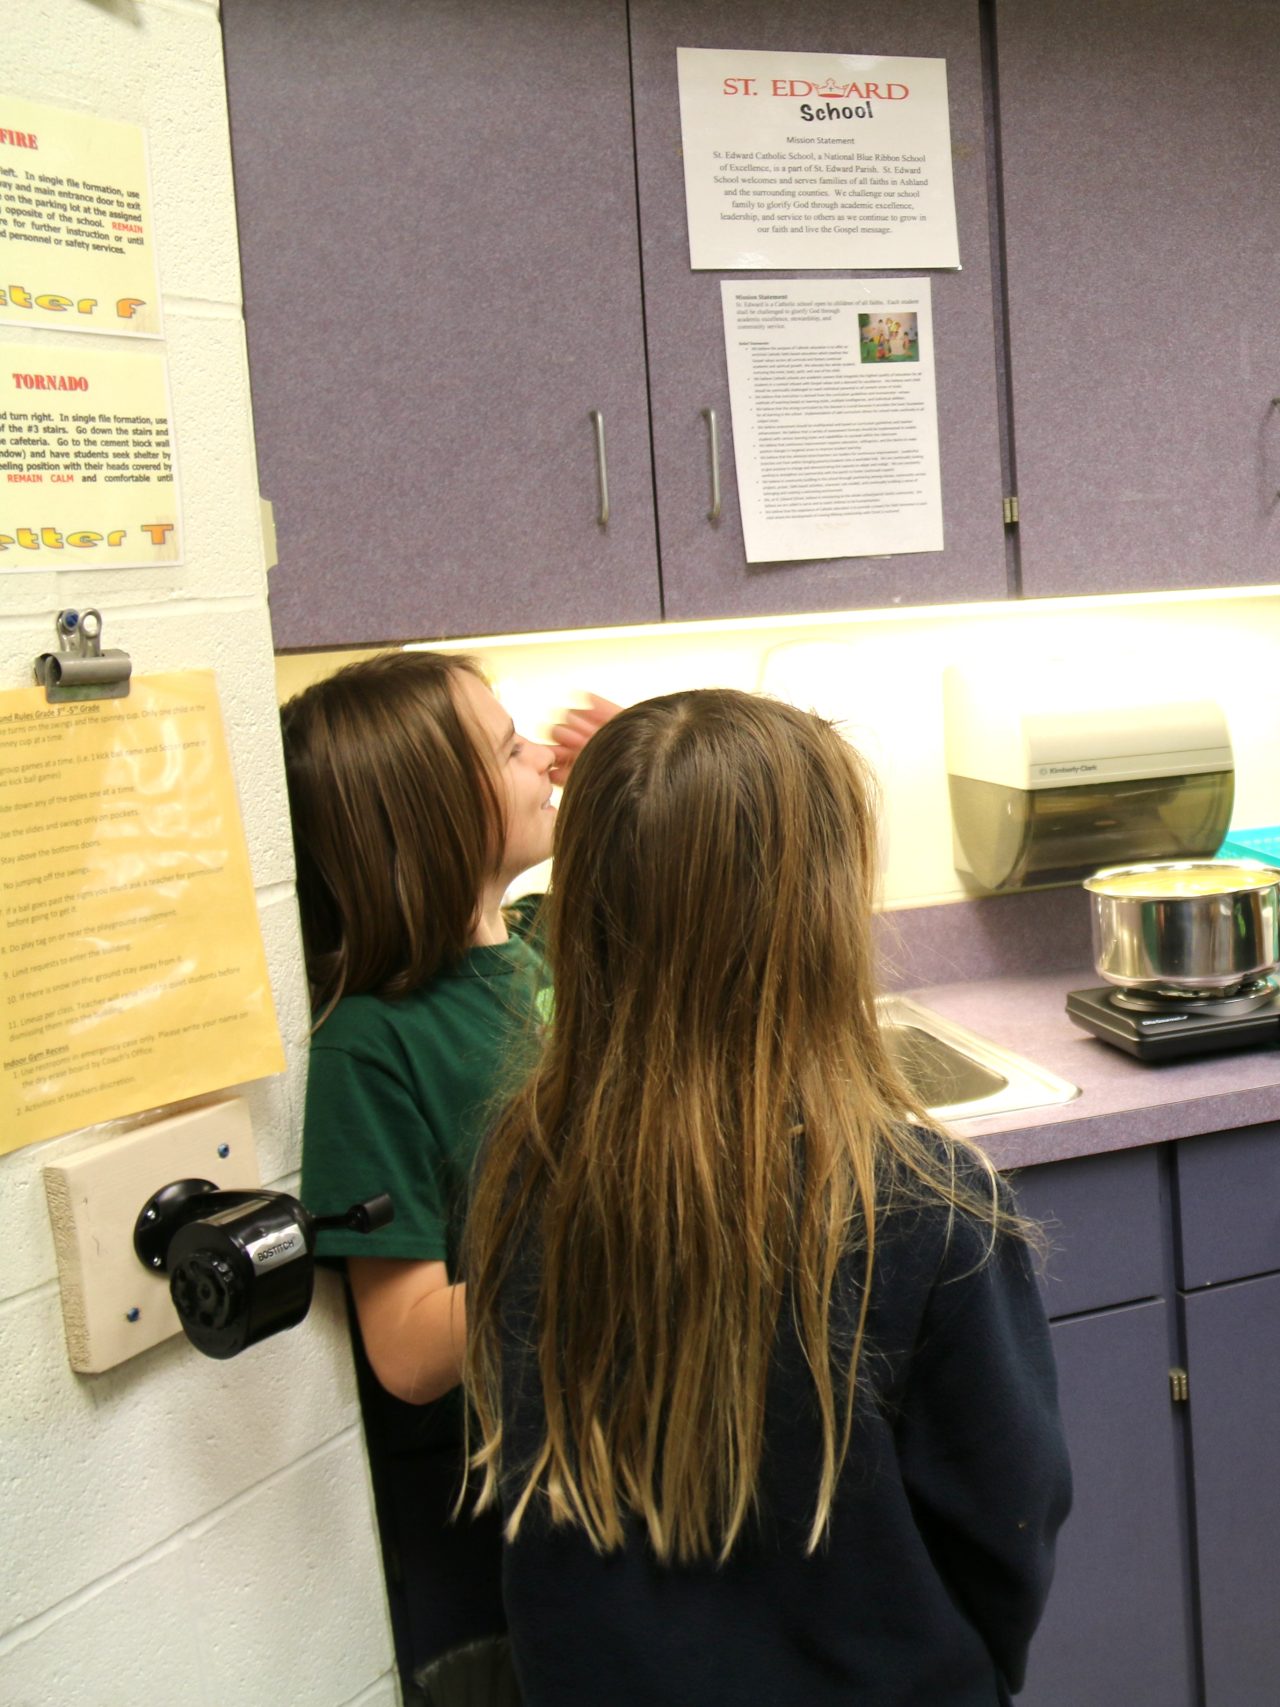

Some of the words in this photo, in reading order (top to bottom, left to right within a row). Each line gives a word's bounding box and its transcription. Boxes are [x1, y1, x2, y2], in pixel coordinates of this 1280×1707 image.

[722, 77, 758, 96] ST.
[800, 101, 873, 121] School
[0, 128, 38, 150] FIRE
[817, 137, 855, 145] Statement
[0, 166, 18, 178] left.
[38, 174, 64, 186] single
[66, 178, 80, 188] file
[82, 180, 124, 197] formation,
[127, 190, 140, 199] use
[15, 183, 31, 192] and
[34, 186, 55, 196] main
[58, 190, 94, 202] entrance
[96, 196, 114, 206] door
[126, 201, 141, 210] exit
[18, 195, 32, 205] the
[35, 199, 68, 212] parking
[69, 203, 80, 212] lot
[93, 207, 107, 217] the
[109, 210, 142, 222] assigned
[5, 207, 43, 219] opposite
[59, 214, 72, 223] the
[76, 217, 105, 228] school.
[112, 221, 143, 234] REMAIN
[13, 219, 26, 228] for
[31, 221, 61, 233] further
[66, 226, 110, 241] instruction
[127, 237, 144, 245] until
[9, 231, 52, 244] personnel
[65, 239, 90, 251] safety
[92, 243, 126, 254] services.
[12, 373, 89, 392] TORNADO
[9, 412, 28, 420] turn
[31, 412, 54, 423] right.
[71, 413, 96, 424] single
[98, 414, 111, 423] file
[113, 415, 153, 425] formation,
[8, 424, 23, 433] the
[27, 425, 39, 434] #3
[43, 425, 69, 434] stairs.
[76, 426, 87, 434] Go
[90, 426, 113, 435] down
[116, 427, 129, 435] the
[132, 427, 153, 436] stairs
[155, 428, 169, 436] and
[10, 436, 50, 446] cafeteria.
[57, 438, 69, 446] Go
[84, 438, 97, 446] the
[100, 439, 130, 447] cement
[132, 439, 152, 447] block
[155, 439, 170, 447] wall
[30, 450, 46, 458] and
[50, 450, 70, 458] have
[74, 450, 108, 459] students
[112, 451, 130, 459] seek
[133, 451, 159, 459] shelter
[27, 462, 60, 472] position
[63, 462, 82, 470] with
[84, 462, 103, 470] their
[106, 462, 129, 470] heads
[7, 474, 43, 482] REMAIN
[50, 474, 74, 482] CALM
[81, 474, 96, 482] and
[104, 474, 150, 482] comfortable
[157, 474, 173, 482] until
[141, 523, 174, 545] T
[14, 711, 34, 721] Rules
[35, 709, 55, 719] Grade
[80, 704, 100, 714] Grade
[257, 1238, 295, 1262] BOSTITCH
